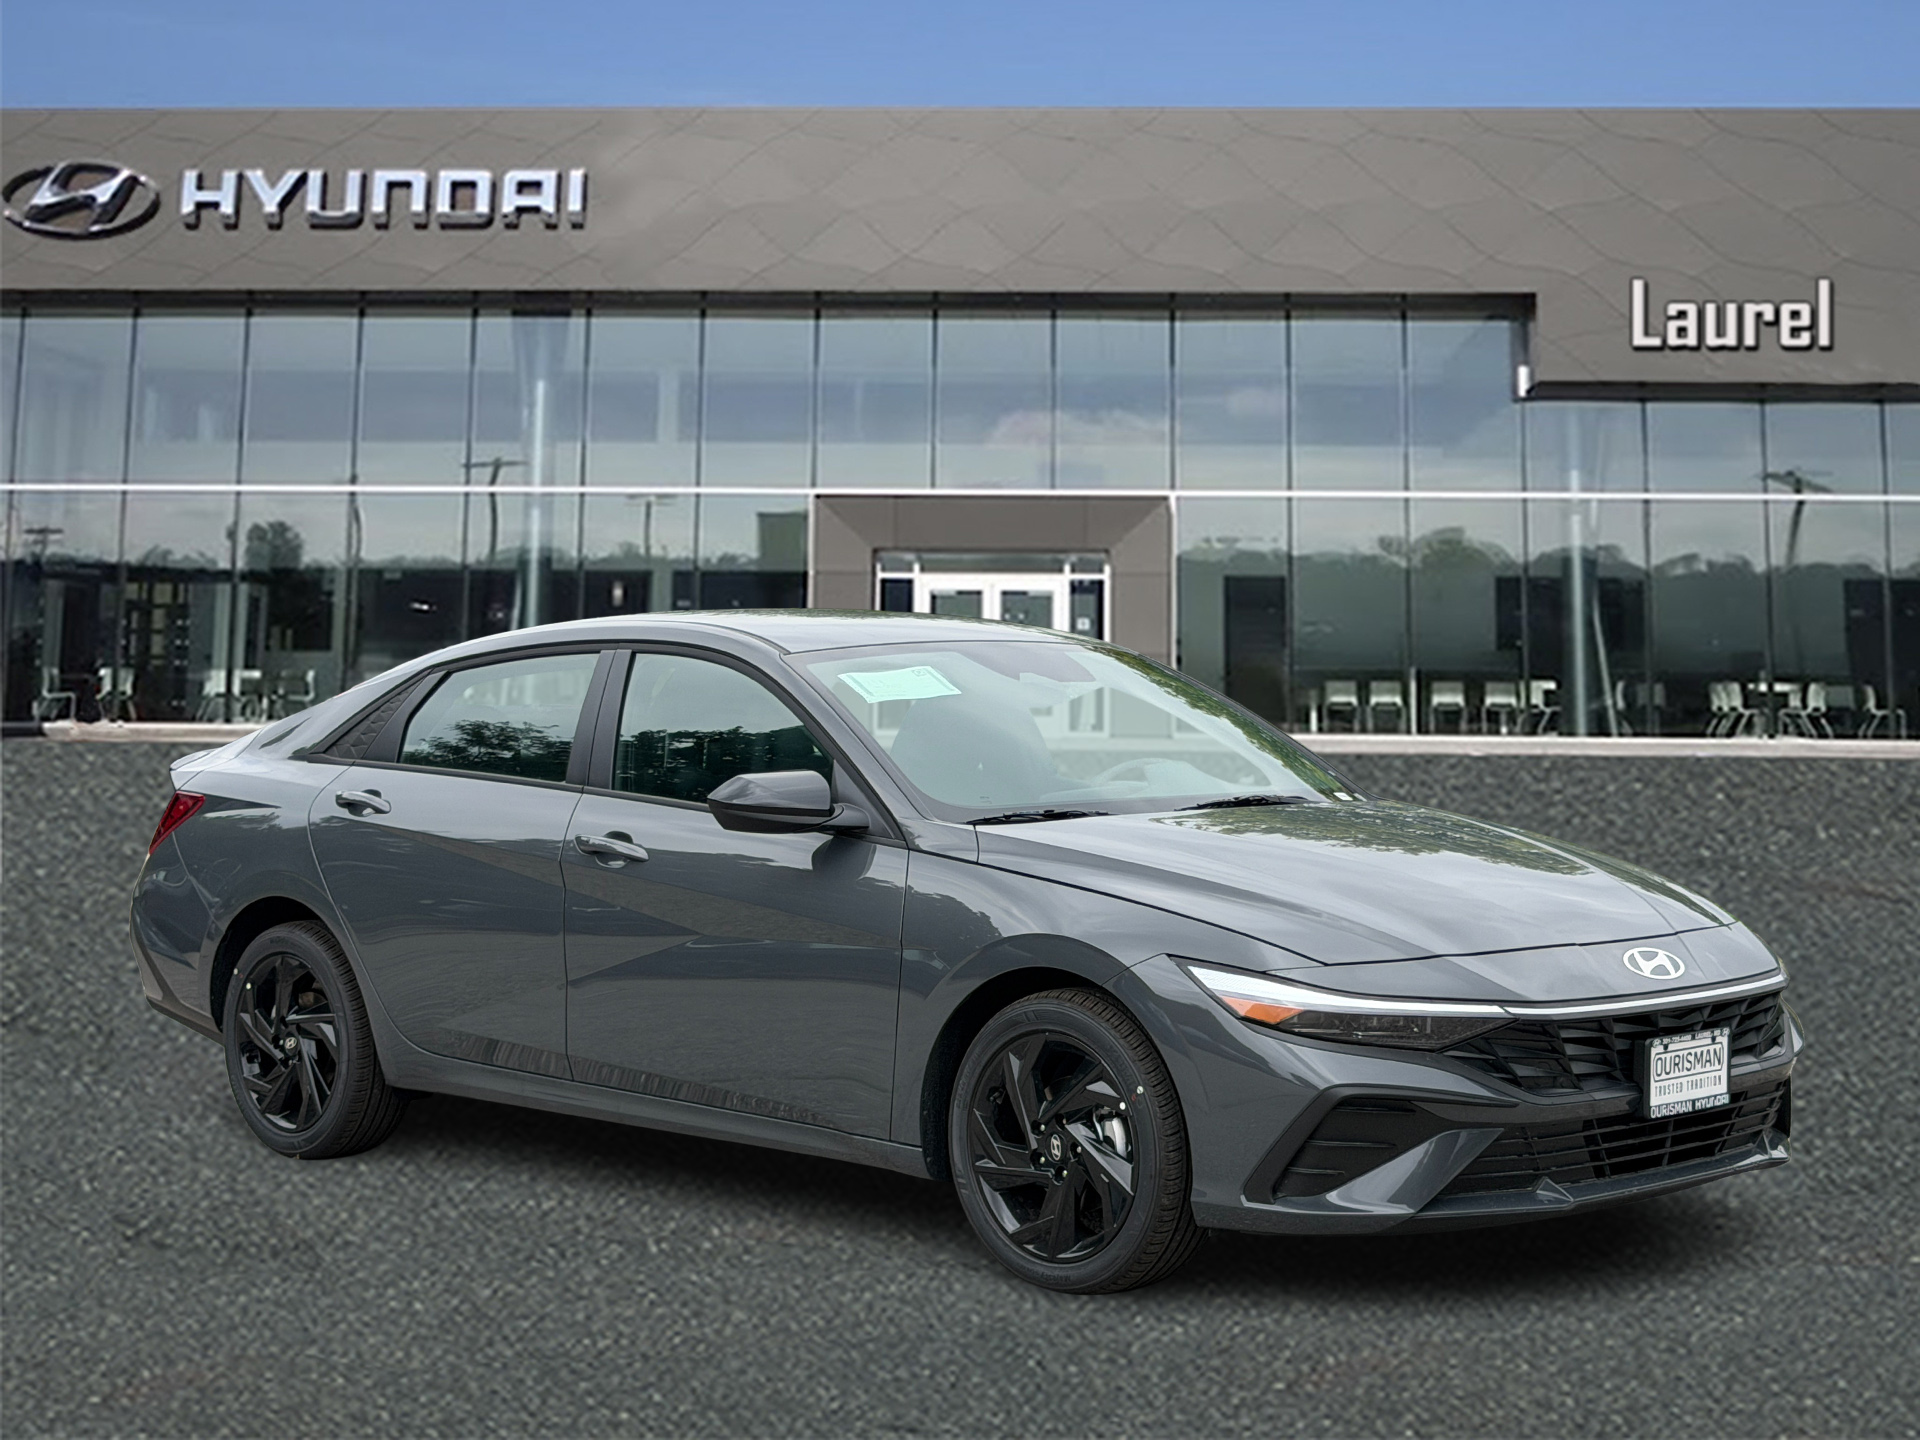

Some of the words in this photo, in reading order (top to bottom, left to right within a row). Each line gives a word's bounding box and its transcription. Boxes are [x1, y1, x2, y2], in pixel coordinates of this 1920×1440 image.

[180, 168, 587, 230] HYUNDAI
[1631, 278, 1832, 350] Laurel
[1655, 1047, 1721, 1077] OURISMAN
[1655, 1081, 1683, 1097] TRUSTED
[1686, 1075, 1722, 1092] TRADITION
[1650, 1100, 1693, 1119] OURISMAN
[1694, 1094, 1730, 1110] HYUNDAI
